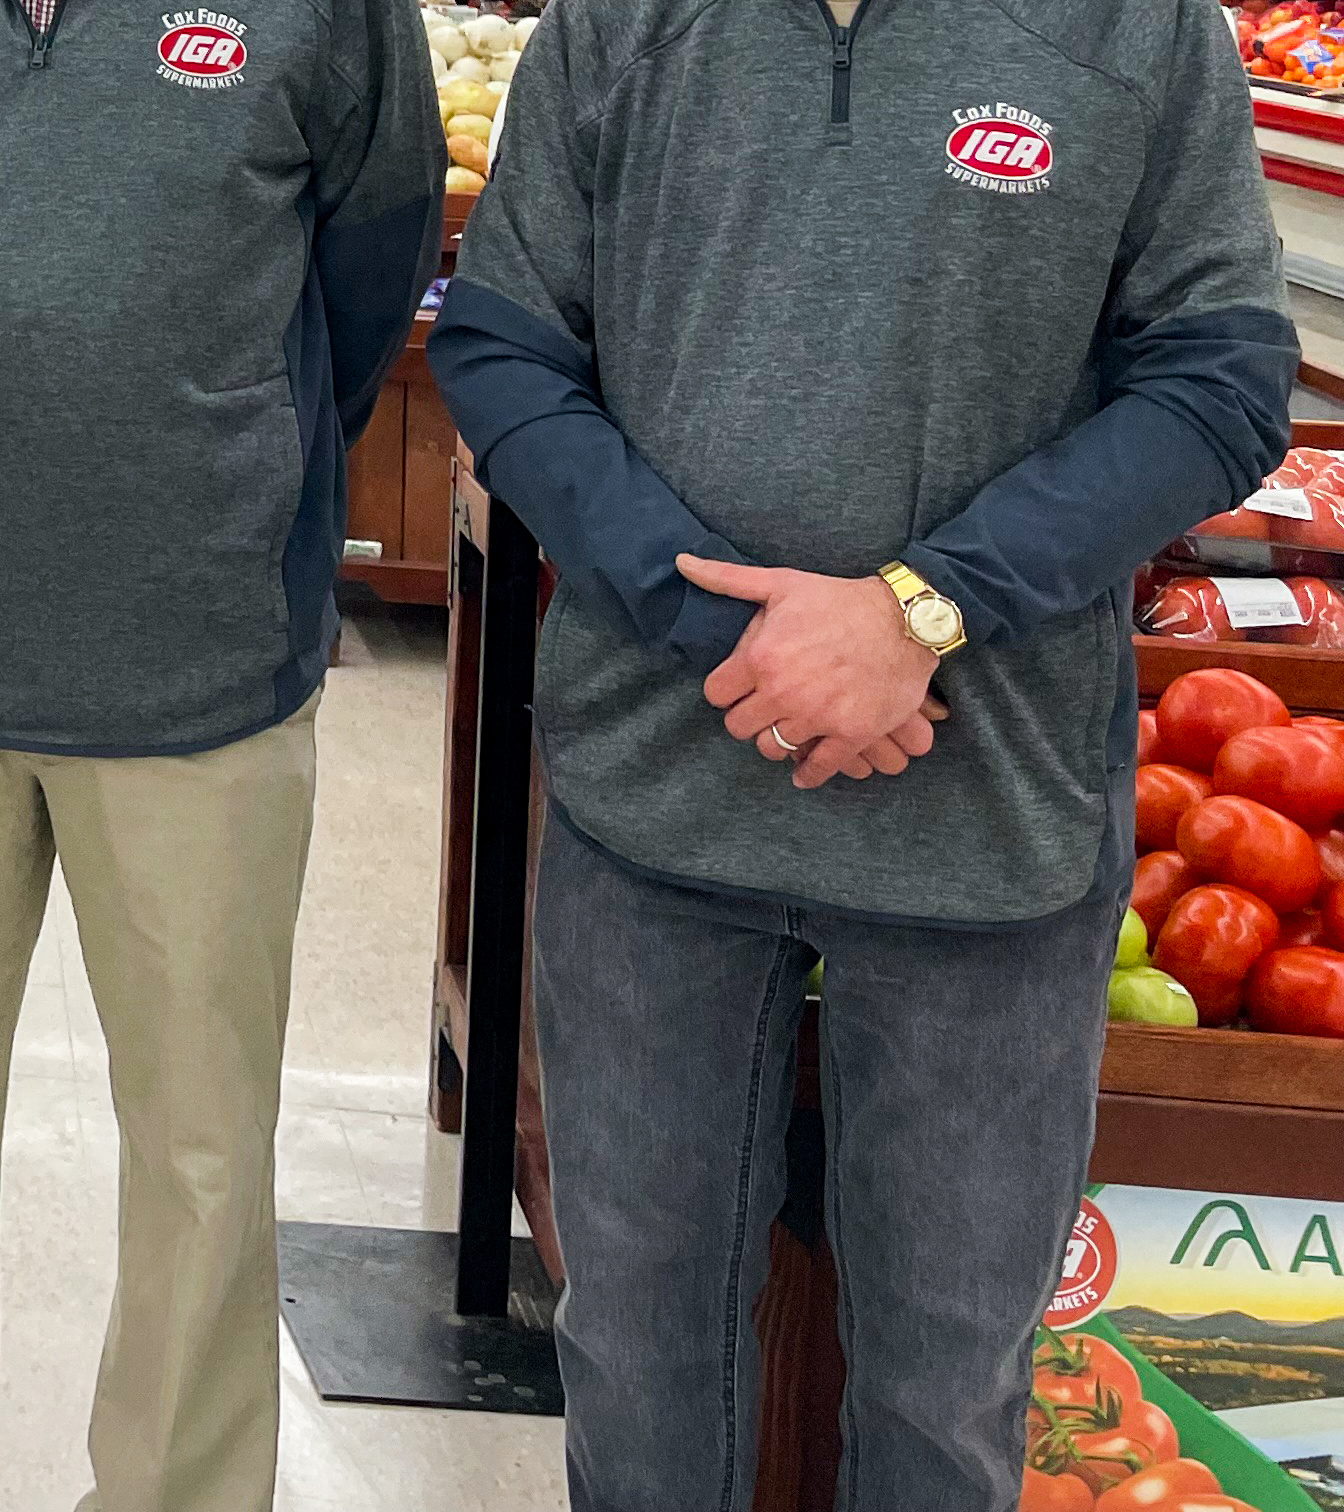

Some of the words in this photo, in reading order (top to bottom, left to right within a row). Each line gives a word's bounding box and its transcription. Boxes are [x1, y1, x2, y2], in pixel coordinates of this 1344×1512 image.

[167, 33, 239, 66] IGA
[156, 64, 245, 89] SUPERMARKETS
[957, 128, 1045, 168] IGA
[944, 162, 1050, 193] SUPERMARKETS
